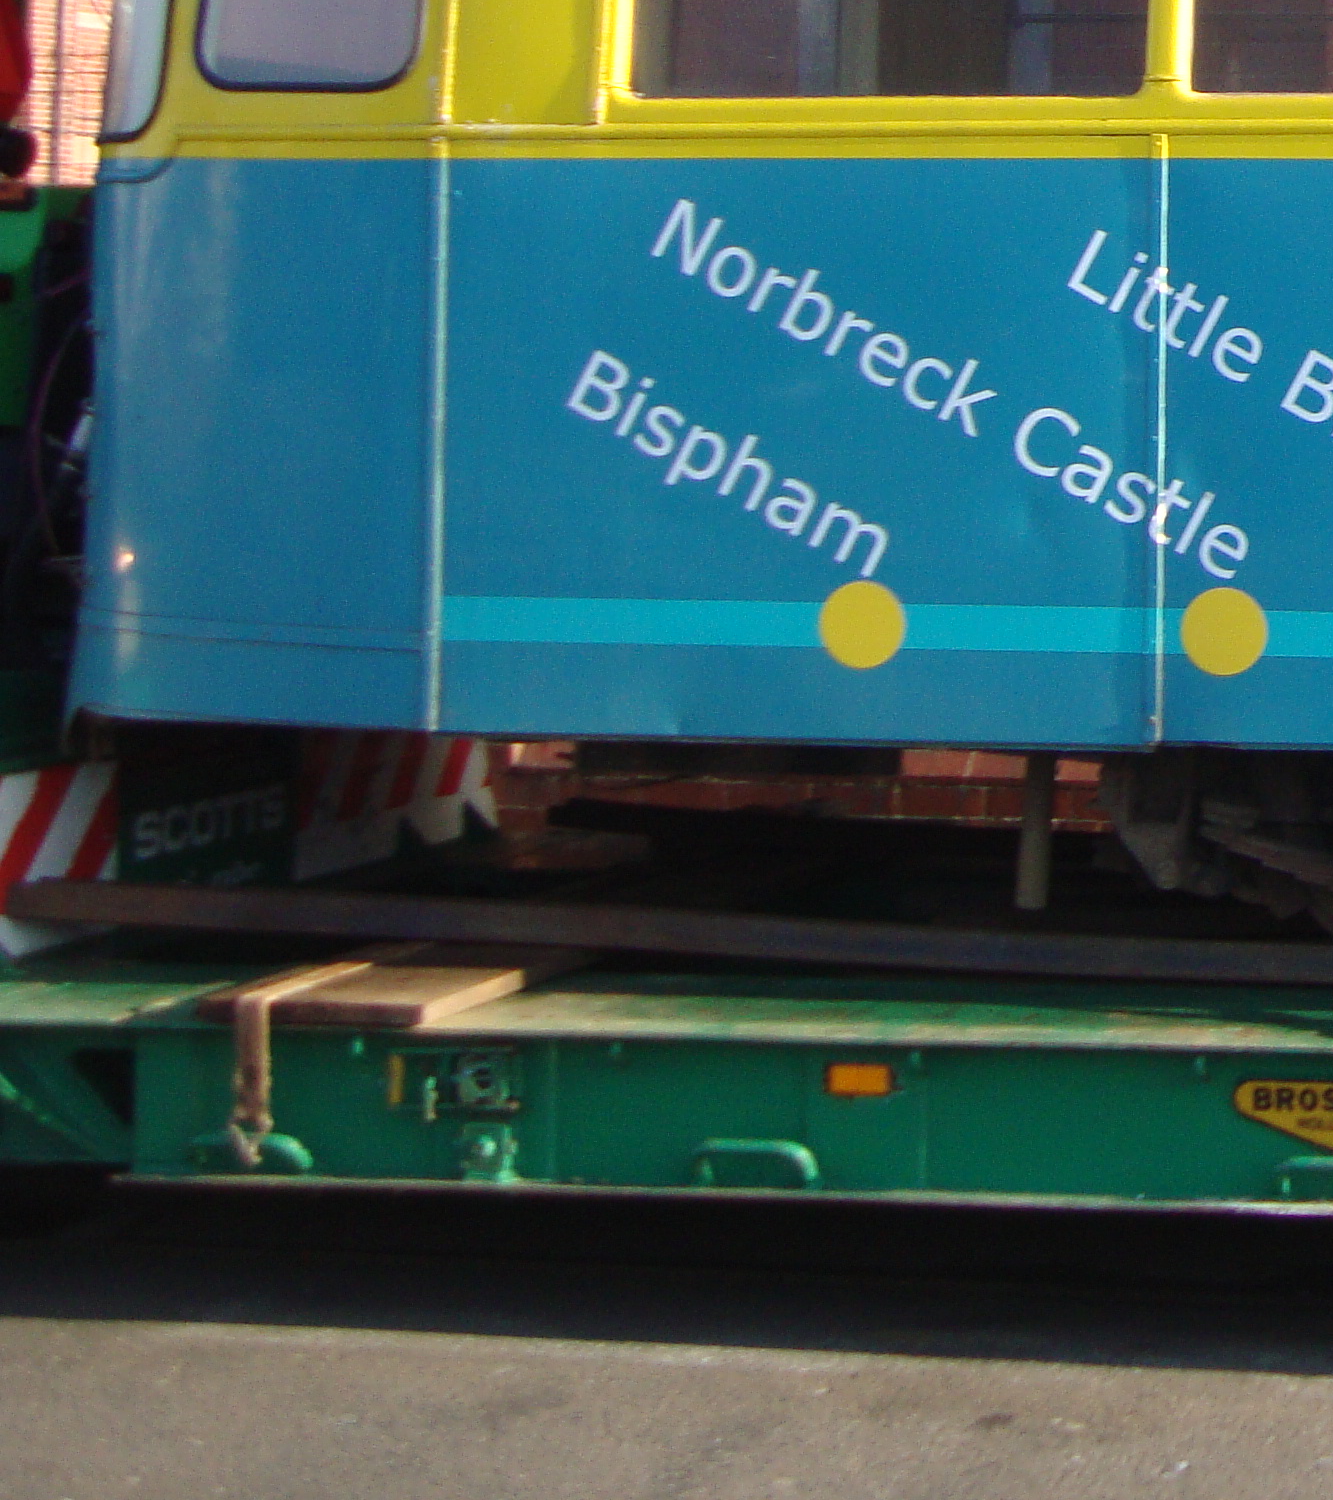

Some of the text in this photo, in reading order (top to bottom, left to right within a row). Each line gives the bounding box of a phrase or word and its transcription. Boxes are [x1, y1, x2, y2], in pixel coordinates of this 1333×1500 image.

[651, 198, 1250, 580] Norbreck Castle
[1067, 229, 1264, 383] Little
[566, 350, 889, 578] Bispham
[134, 783, 286, 861] SCOTTS
